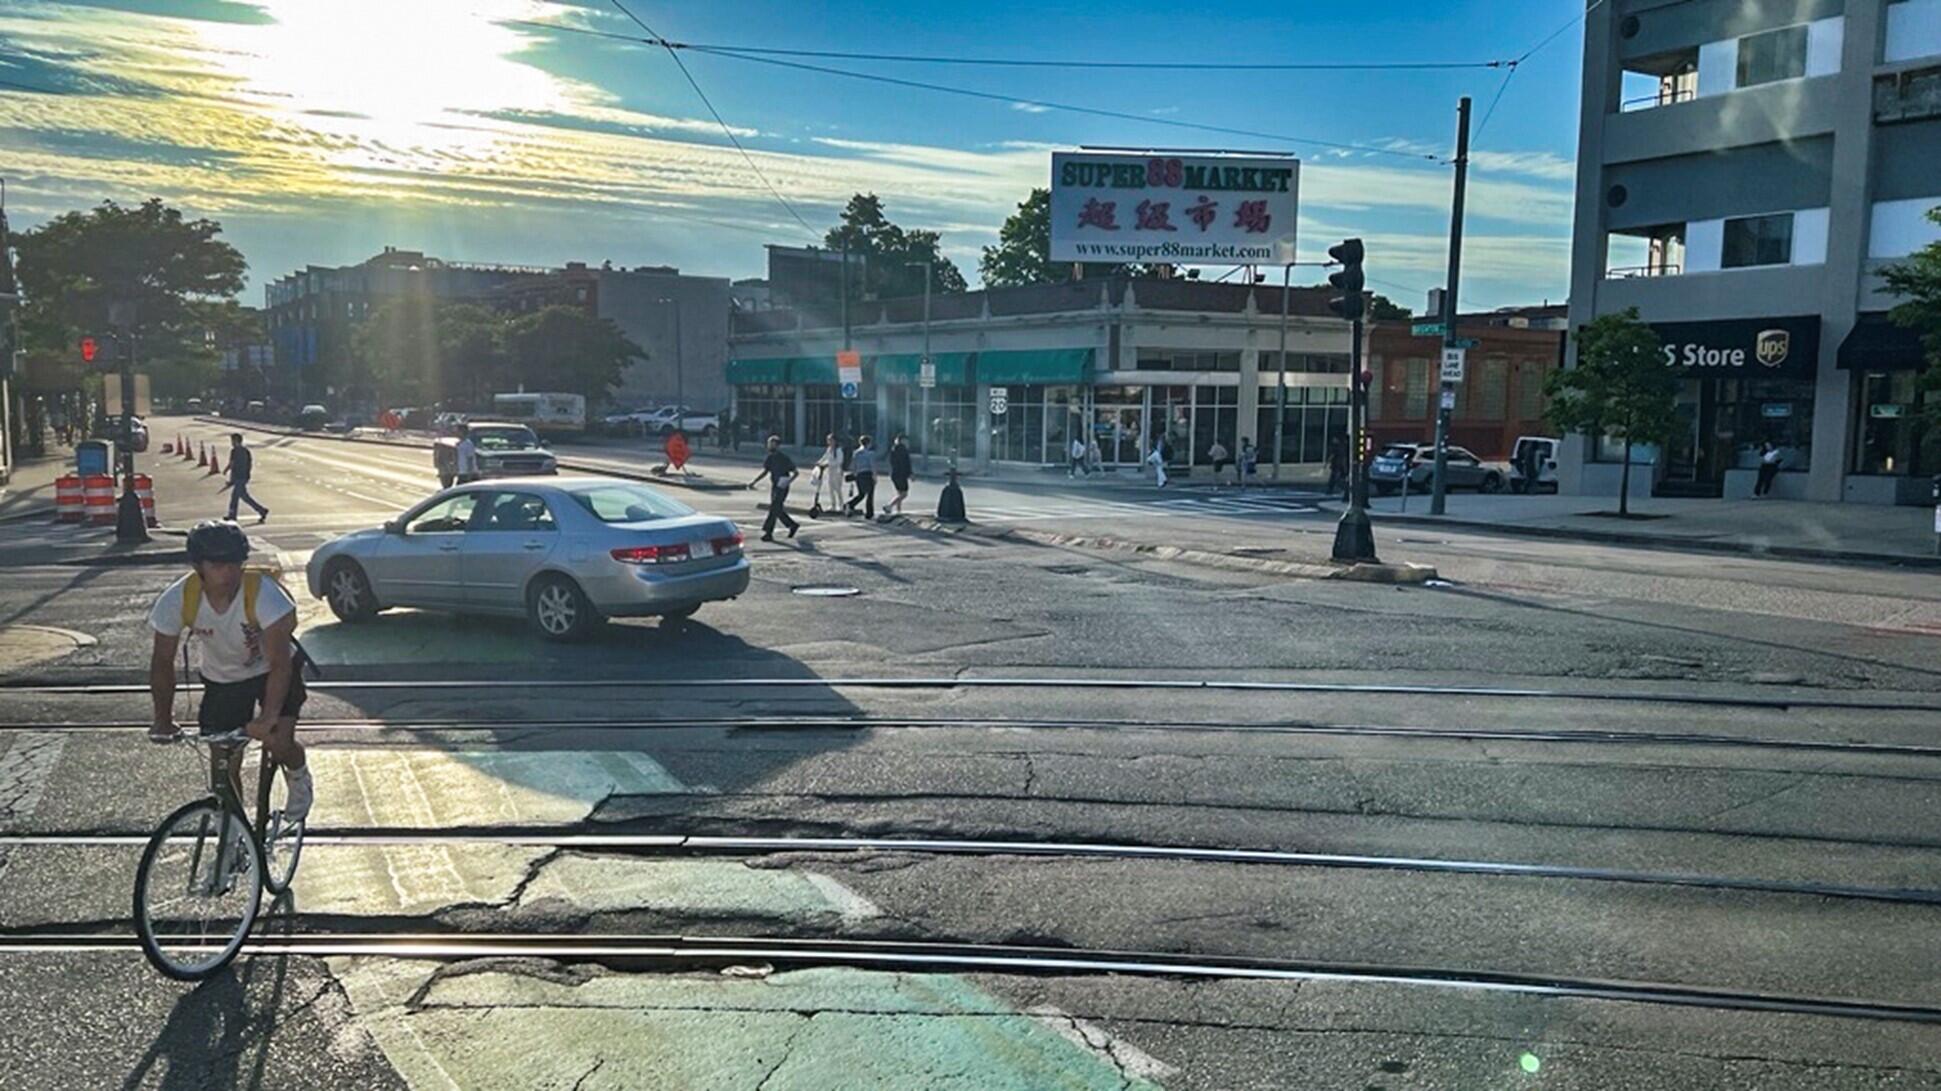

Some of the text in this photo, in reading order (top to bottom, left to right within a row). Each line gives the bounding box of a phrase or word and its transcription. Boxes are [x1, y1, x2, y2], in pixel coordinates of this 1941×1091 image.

[1076, 242, 1271, 260] www.super88market.com
[1682, 343, 1745, 366] Store
[1760, 340, 1785, 361] ups
[992, 400, 1005, 411] 20
